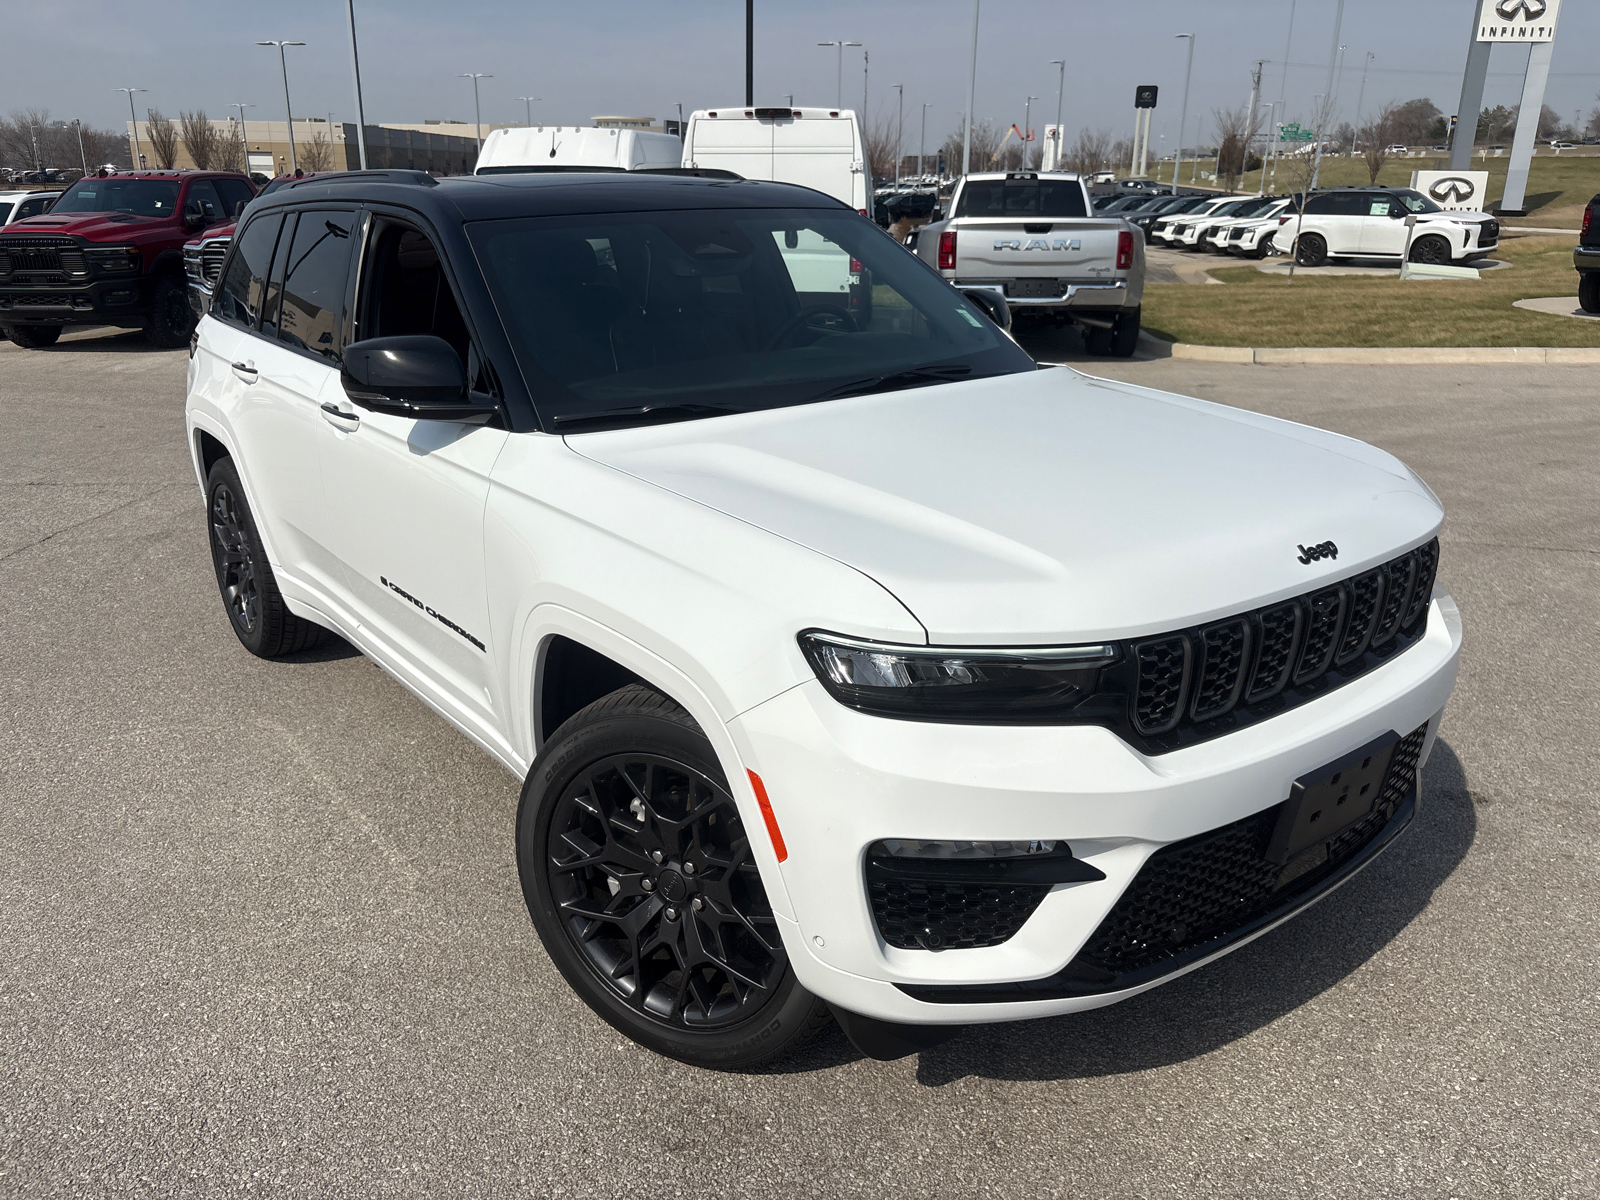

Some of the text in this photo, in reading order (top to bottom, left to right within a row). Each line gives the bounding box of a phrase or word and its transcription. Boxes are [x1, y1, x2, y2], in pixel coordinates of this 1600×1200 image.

[1481, 26, 1552, 37] INFINITI
[993, 239, 1081, 251] RAM
[1296, 540, 1339, 566] Jeep
[388, 581, 425, 610] GRAND
